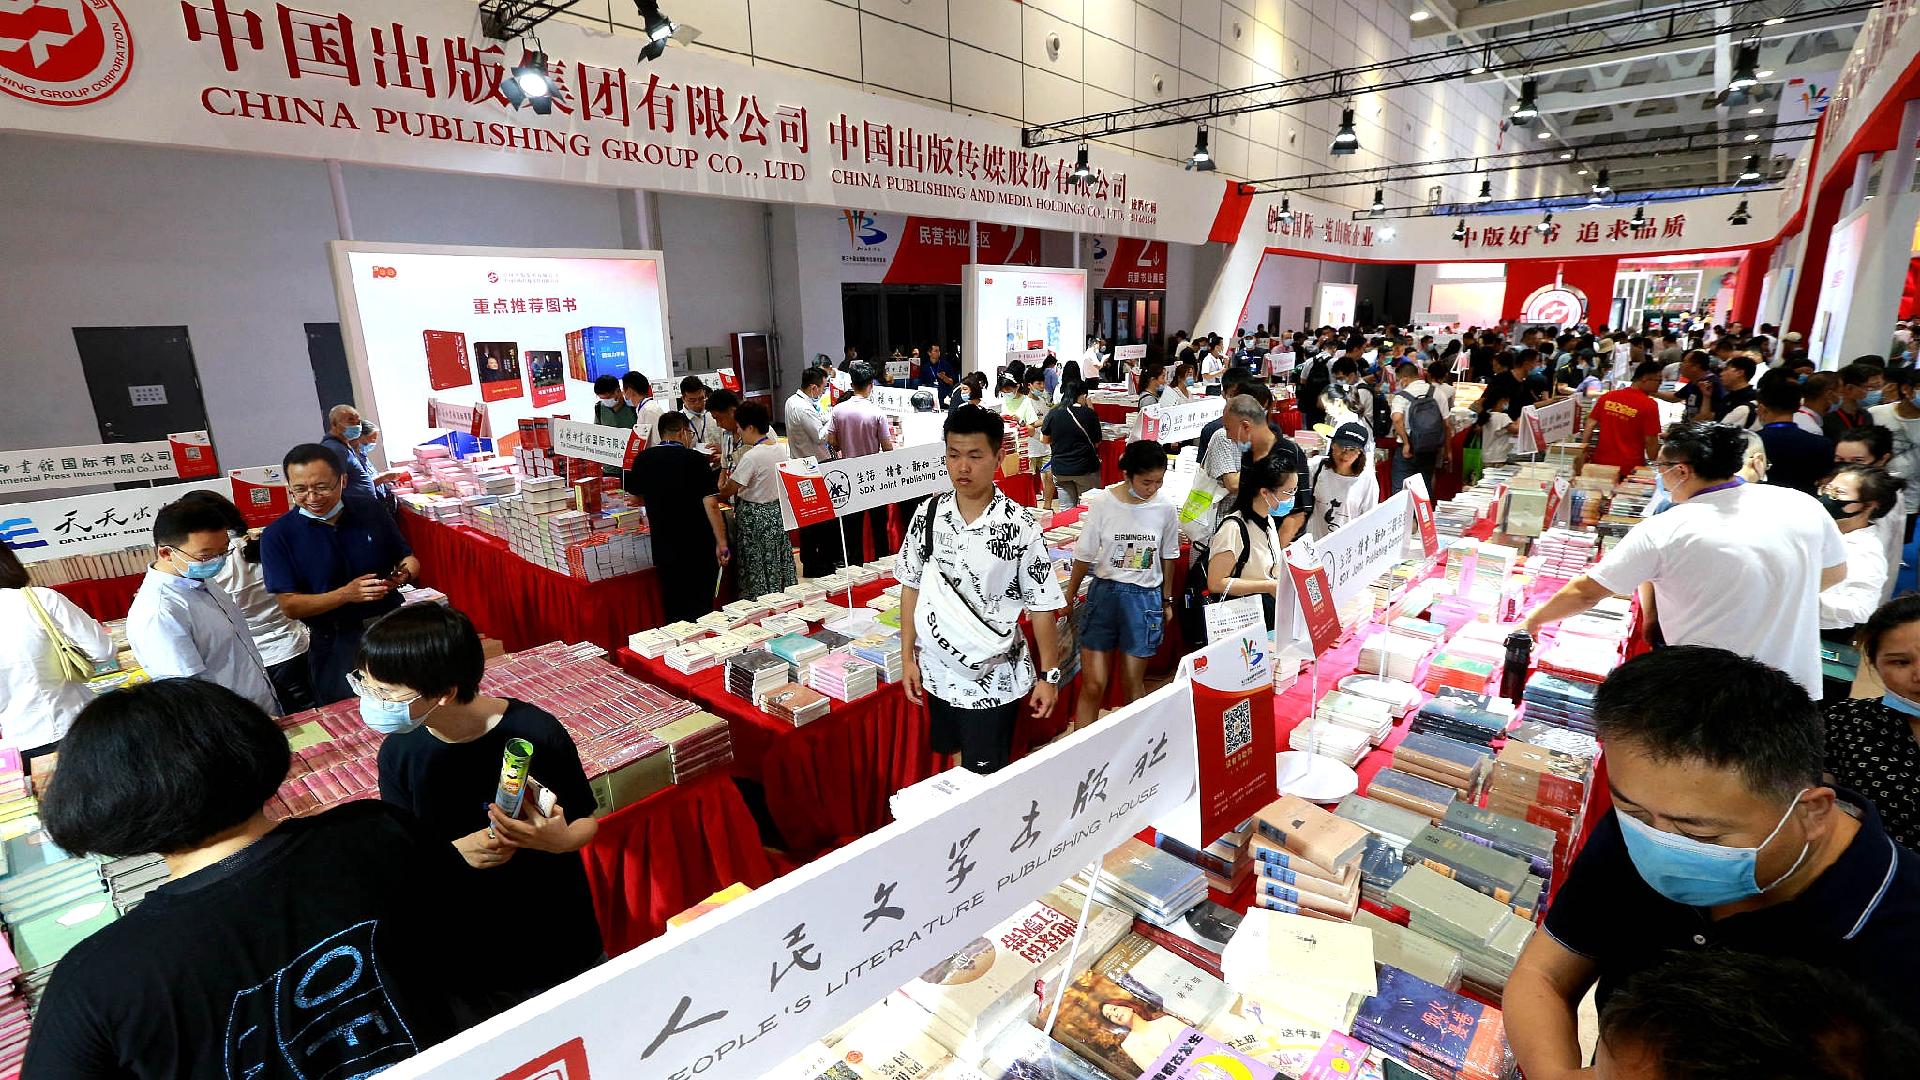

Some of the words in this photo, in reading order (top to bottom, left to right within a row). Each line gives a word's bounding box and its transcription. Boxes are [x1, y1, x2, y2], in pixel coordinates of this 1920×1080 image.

[40, 87, 90, 99] GROUP
[92, 22, 126, 92] CORPORATION
[200, 86, 361, 131] CHINA
[371, 107, 591, 157] PUBLISHING
[601, 137, 699, 170] GROUP
[764, 159, 806, 182] LTD
[832, 168, 881, 190] CHINA
[887, 175, 966, 201] PUBLISHING
[970, 188, 995, 205] AND
[998, 191, 1033, 209] MEDIA
[1036, 196, 1086, 217] HOLDINGS
[1575, 213, 1687, 246] 追求品质
[472, 297, 578, 316] 重点推荐图书
[1015, 295, 1054, 307] 重点推荐图书
[44, 471, 71, 481] Press
[73, 466, 134, 479] International
[859, 484, 876, 495] SDX
[879, 480, 897, 491] Joint
[901, 471, 936, 487] Publishing
[59, 532, 120, 545] DAYLIGHT
[1114, 533, 1156, 543] BIRMINGHAM
[926, 610, 981, 671] SUBTLE
[824, 891, 985, 998] LITERATURE
[996, 820, 1101, 893] PUBLISHING
[1107, 783, 1160, 821] HOUSE
[1281, 1028, 1321, 1039] 这件事
